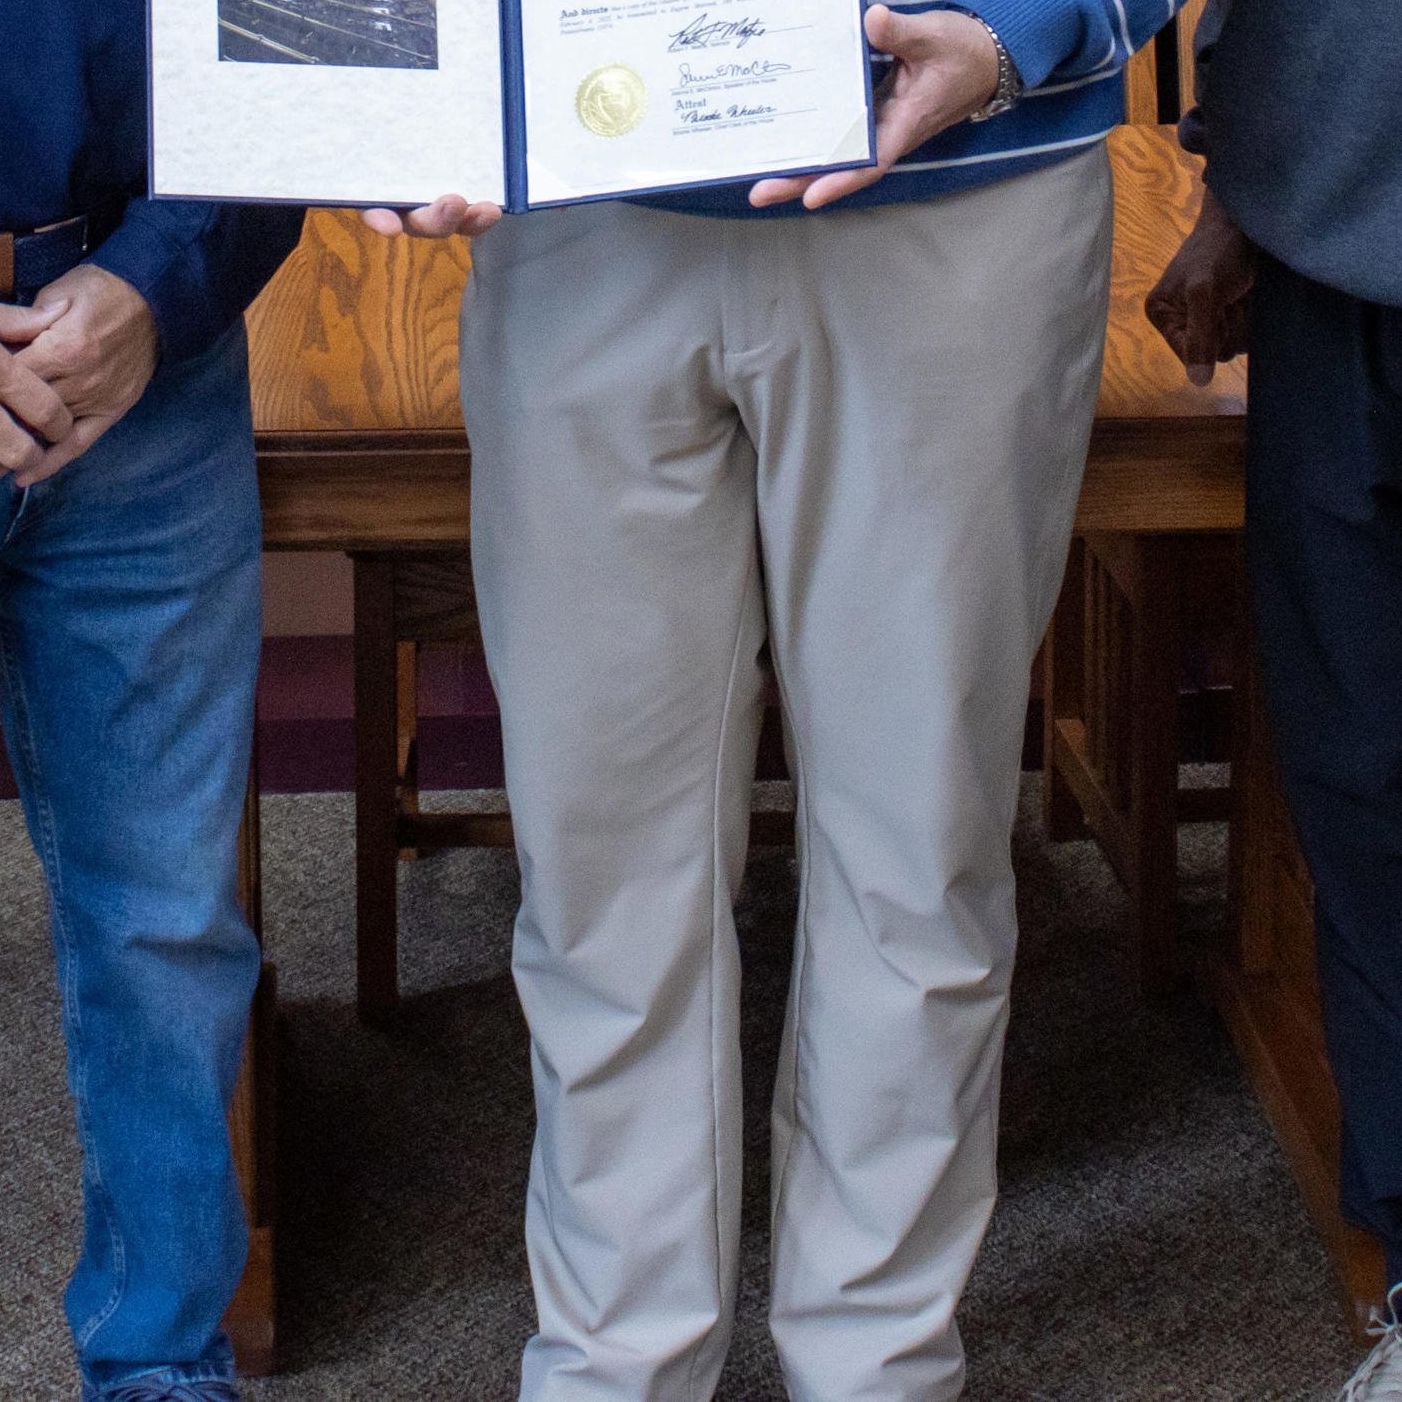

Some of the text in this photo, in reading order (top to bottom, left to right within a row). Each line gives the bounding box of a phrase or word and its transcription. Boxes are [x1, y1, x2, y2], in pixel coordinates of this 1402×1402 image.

[560, 7, 608, 18] And directs
[675, 98, 706, 110] Attest
